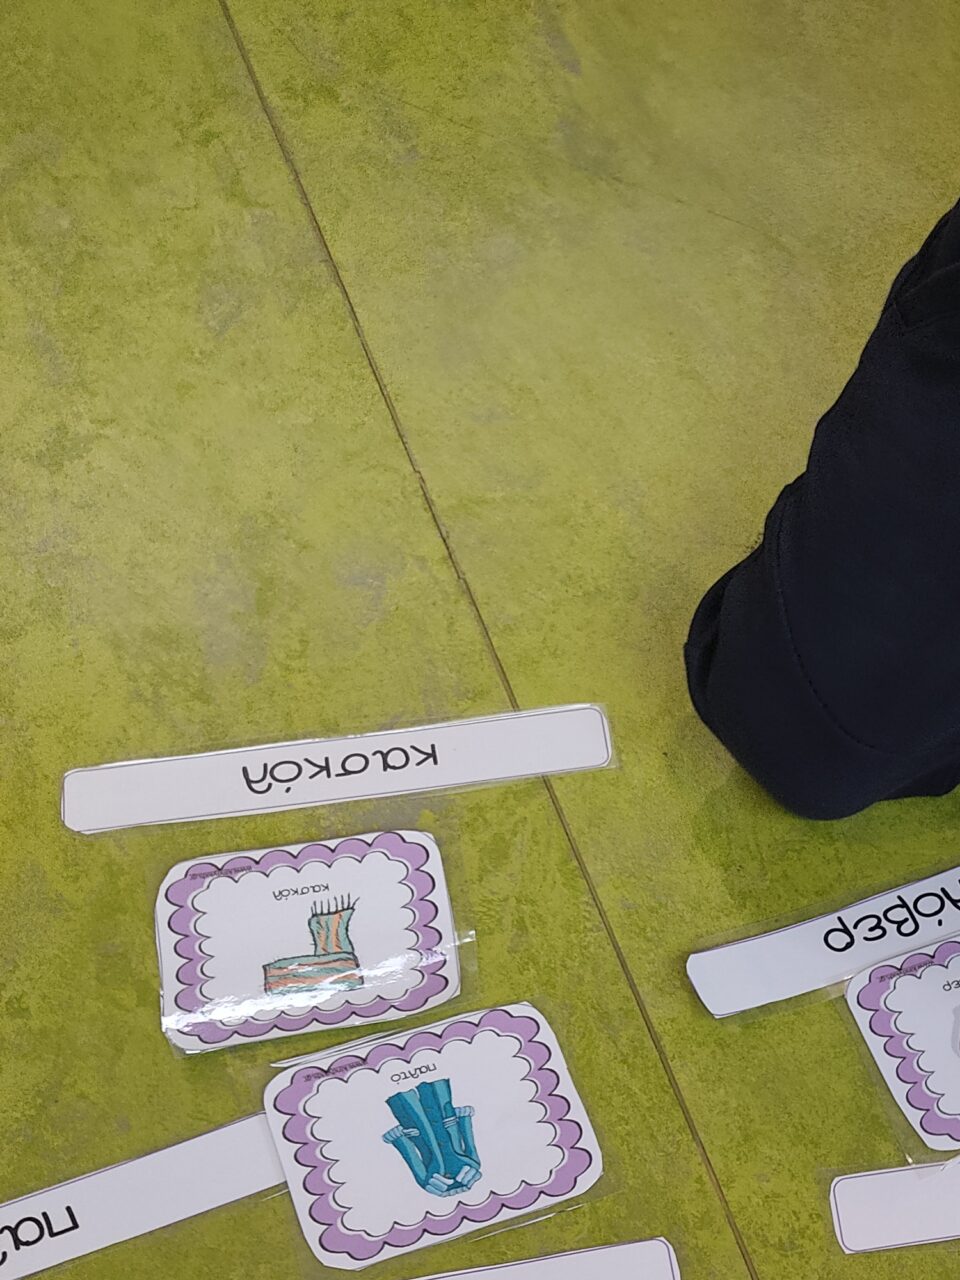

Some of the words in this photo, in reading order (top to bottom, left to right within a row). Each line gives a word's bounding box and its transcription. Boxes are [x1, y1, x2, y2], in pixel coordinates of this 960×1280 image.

[243, 744, 437, 794] κασκόλ
[272, 883, 330, 901] κασκόλ
[390, 1063, 437, 1085] παλτό
